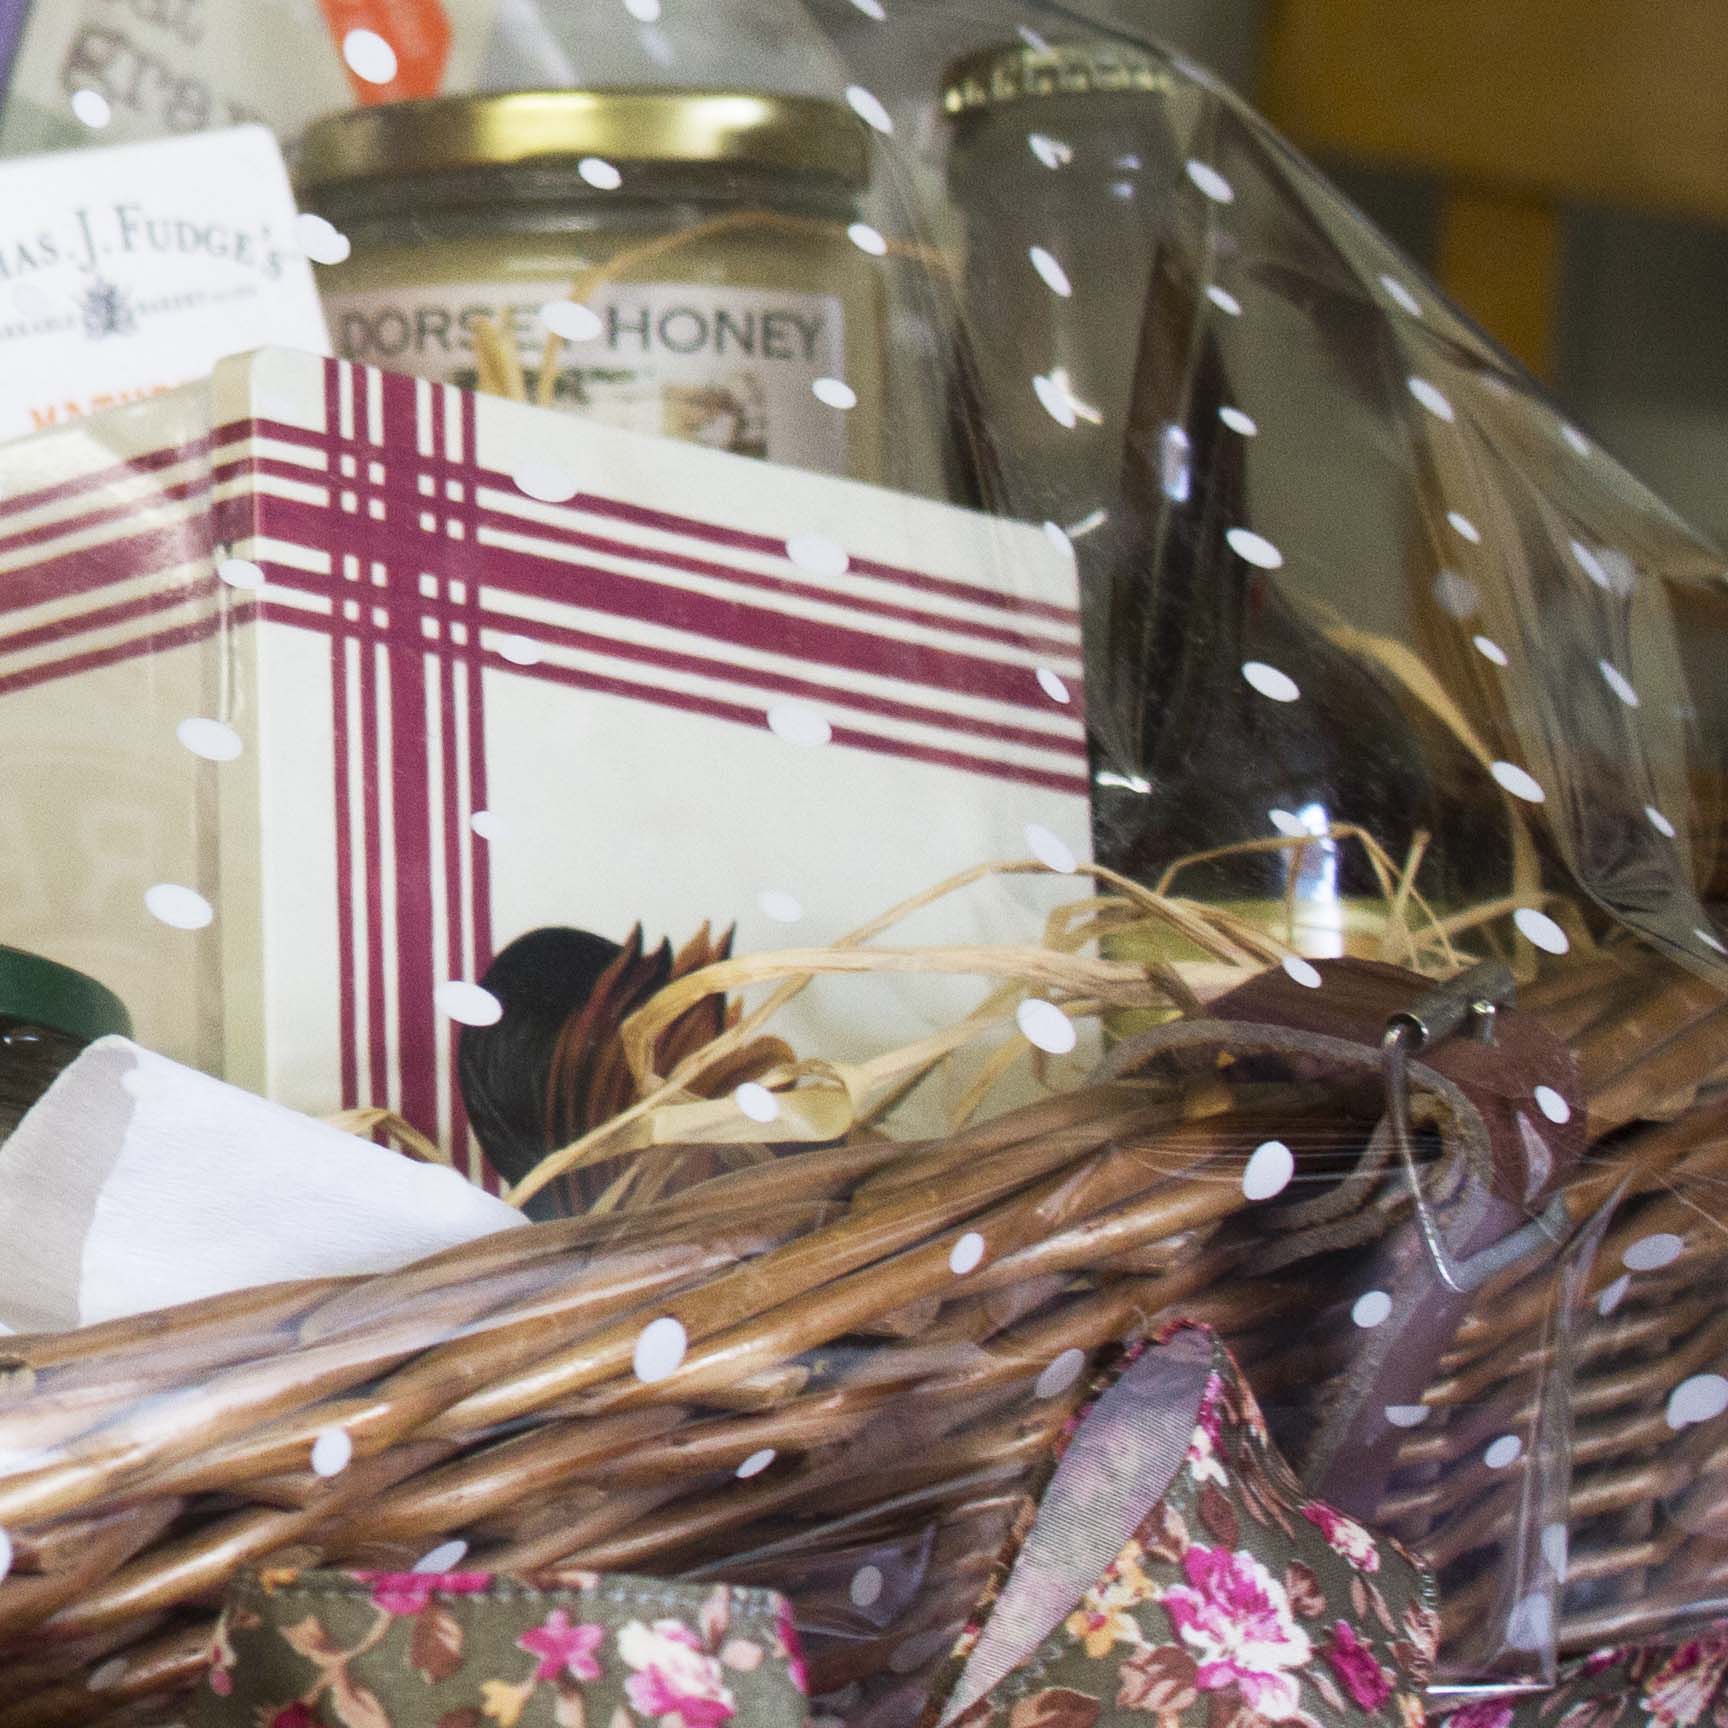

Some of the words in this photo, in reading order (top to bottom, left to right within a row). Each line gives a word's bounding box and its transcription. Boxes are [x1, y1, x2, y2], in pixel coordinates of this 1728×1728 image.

[113, 202, 286, 281] FUDGE'S
[345, 304, 574, 359] DORSE
[605, 305, 827, 363] HONEY
